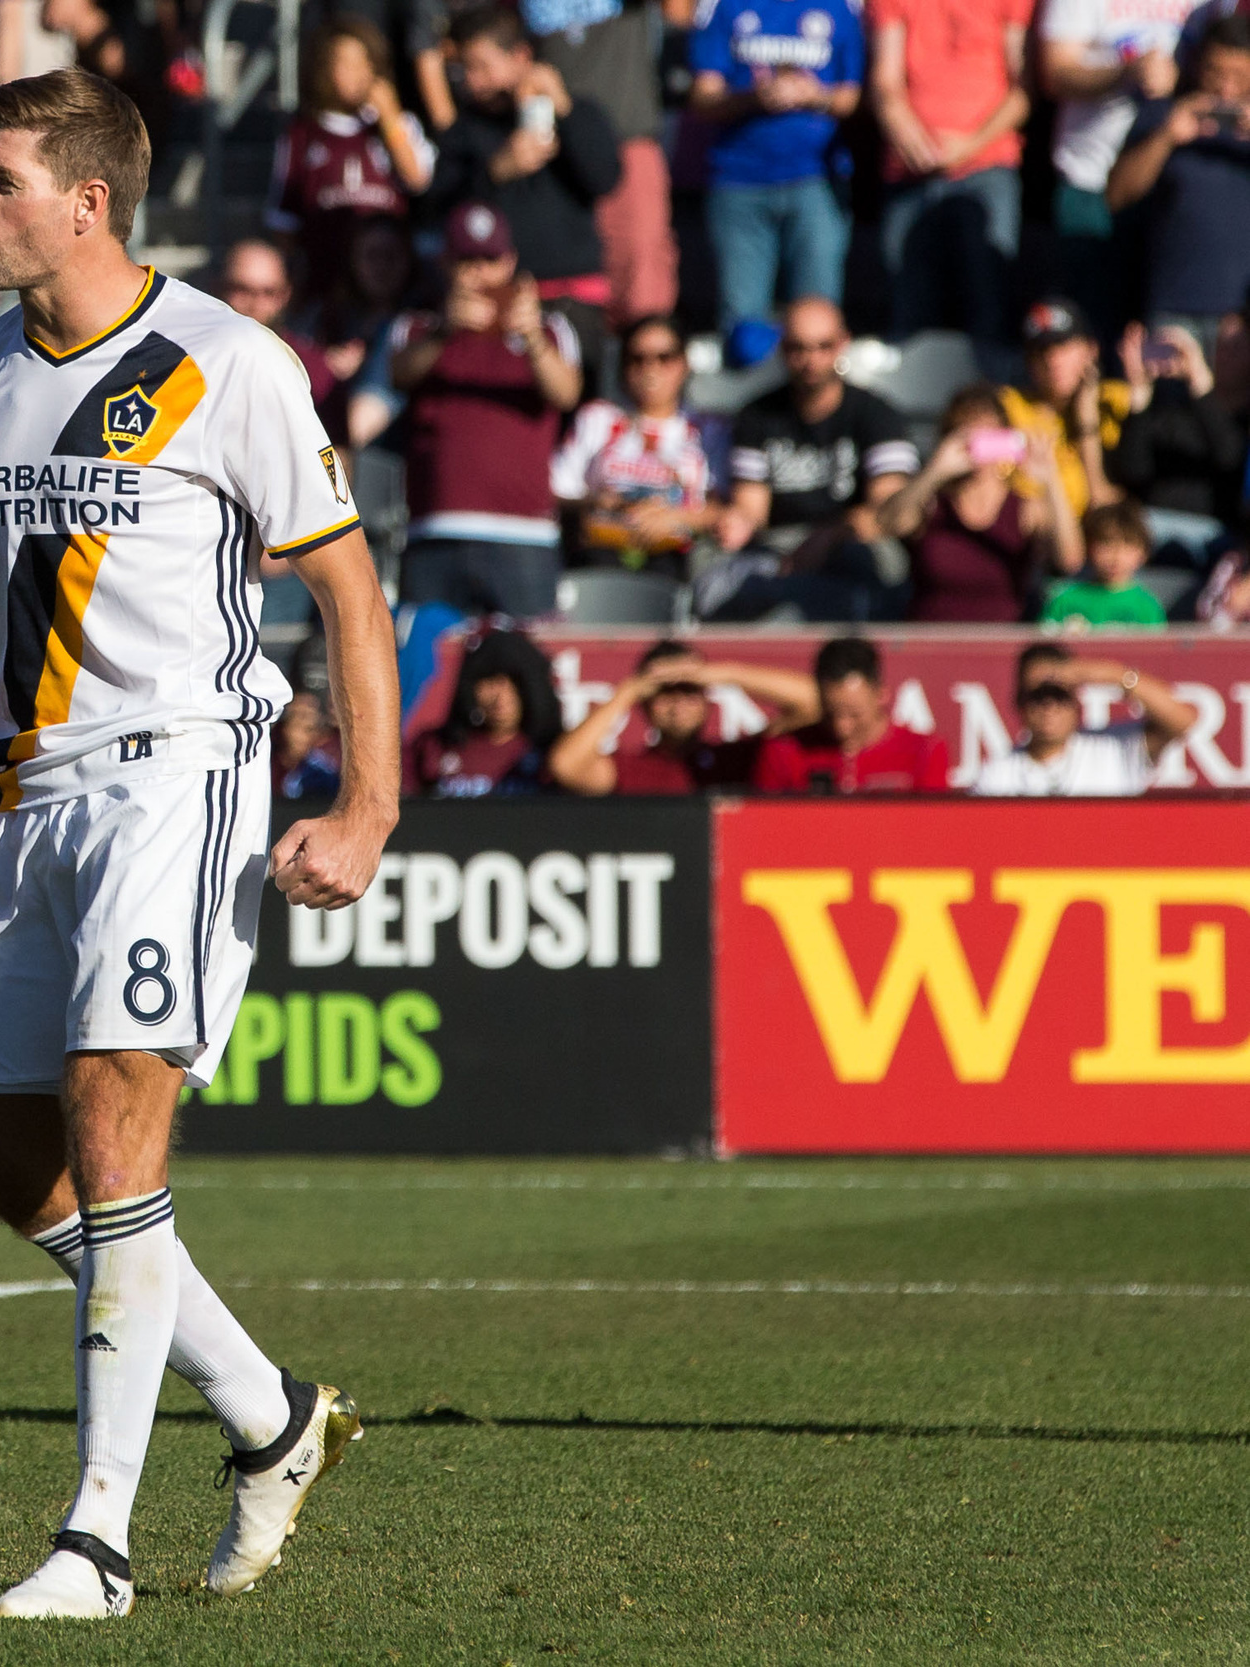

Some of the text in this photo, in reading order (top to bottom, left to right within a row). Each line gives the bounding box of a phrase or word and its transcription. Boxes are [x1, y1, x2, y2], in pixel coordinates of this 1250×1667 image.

[108, 433, 142, 442] GALAXY
[113, 410, 142, 432] LA
[289, 850, 675, 968] DEPOSIT
[123, 938, 177, 1026] 8
[741, 867, 1250, 1085] WE
[200, 989, 443, 1107] PIDS
